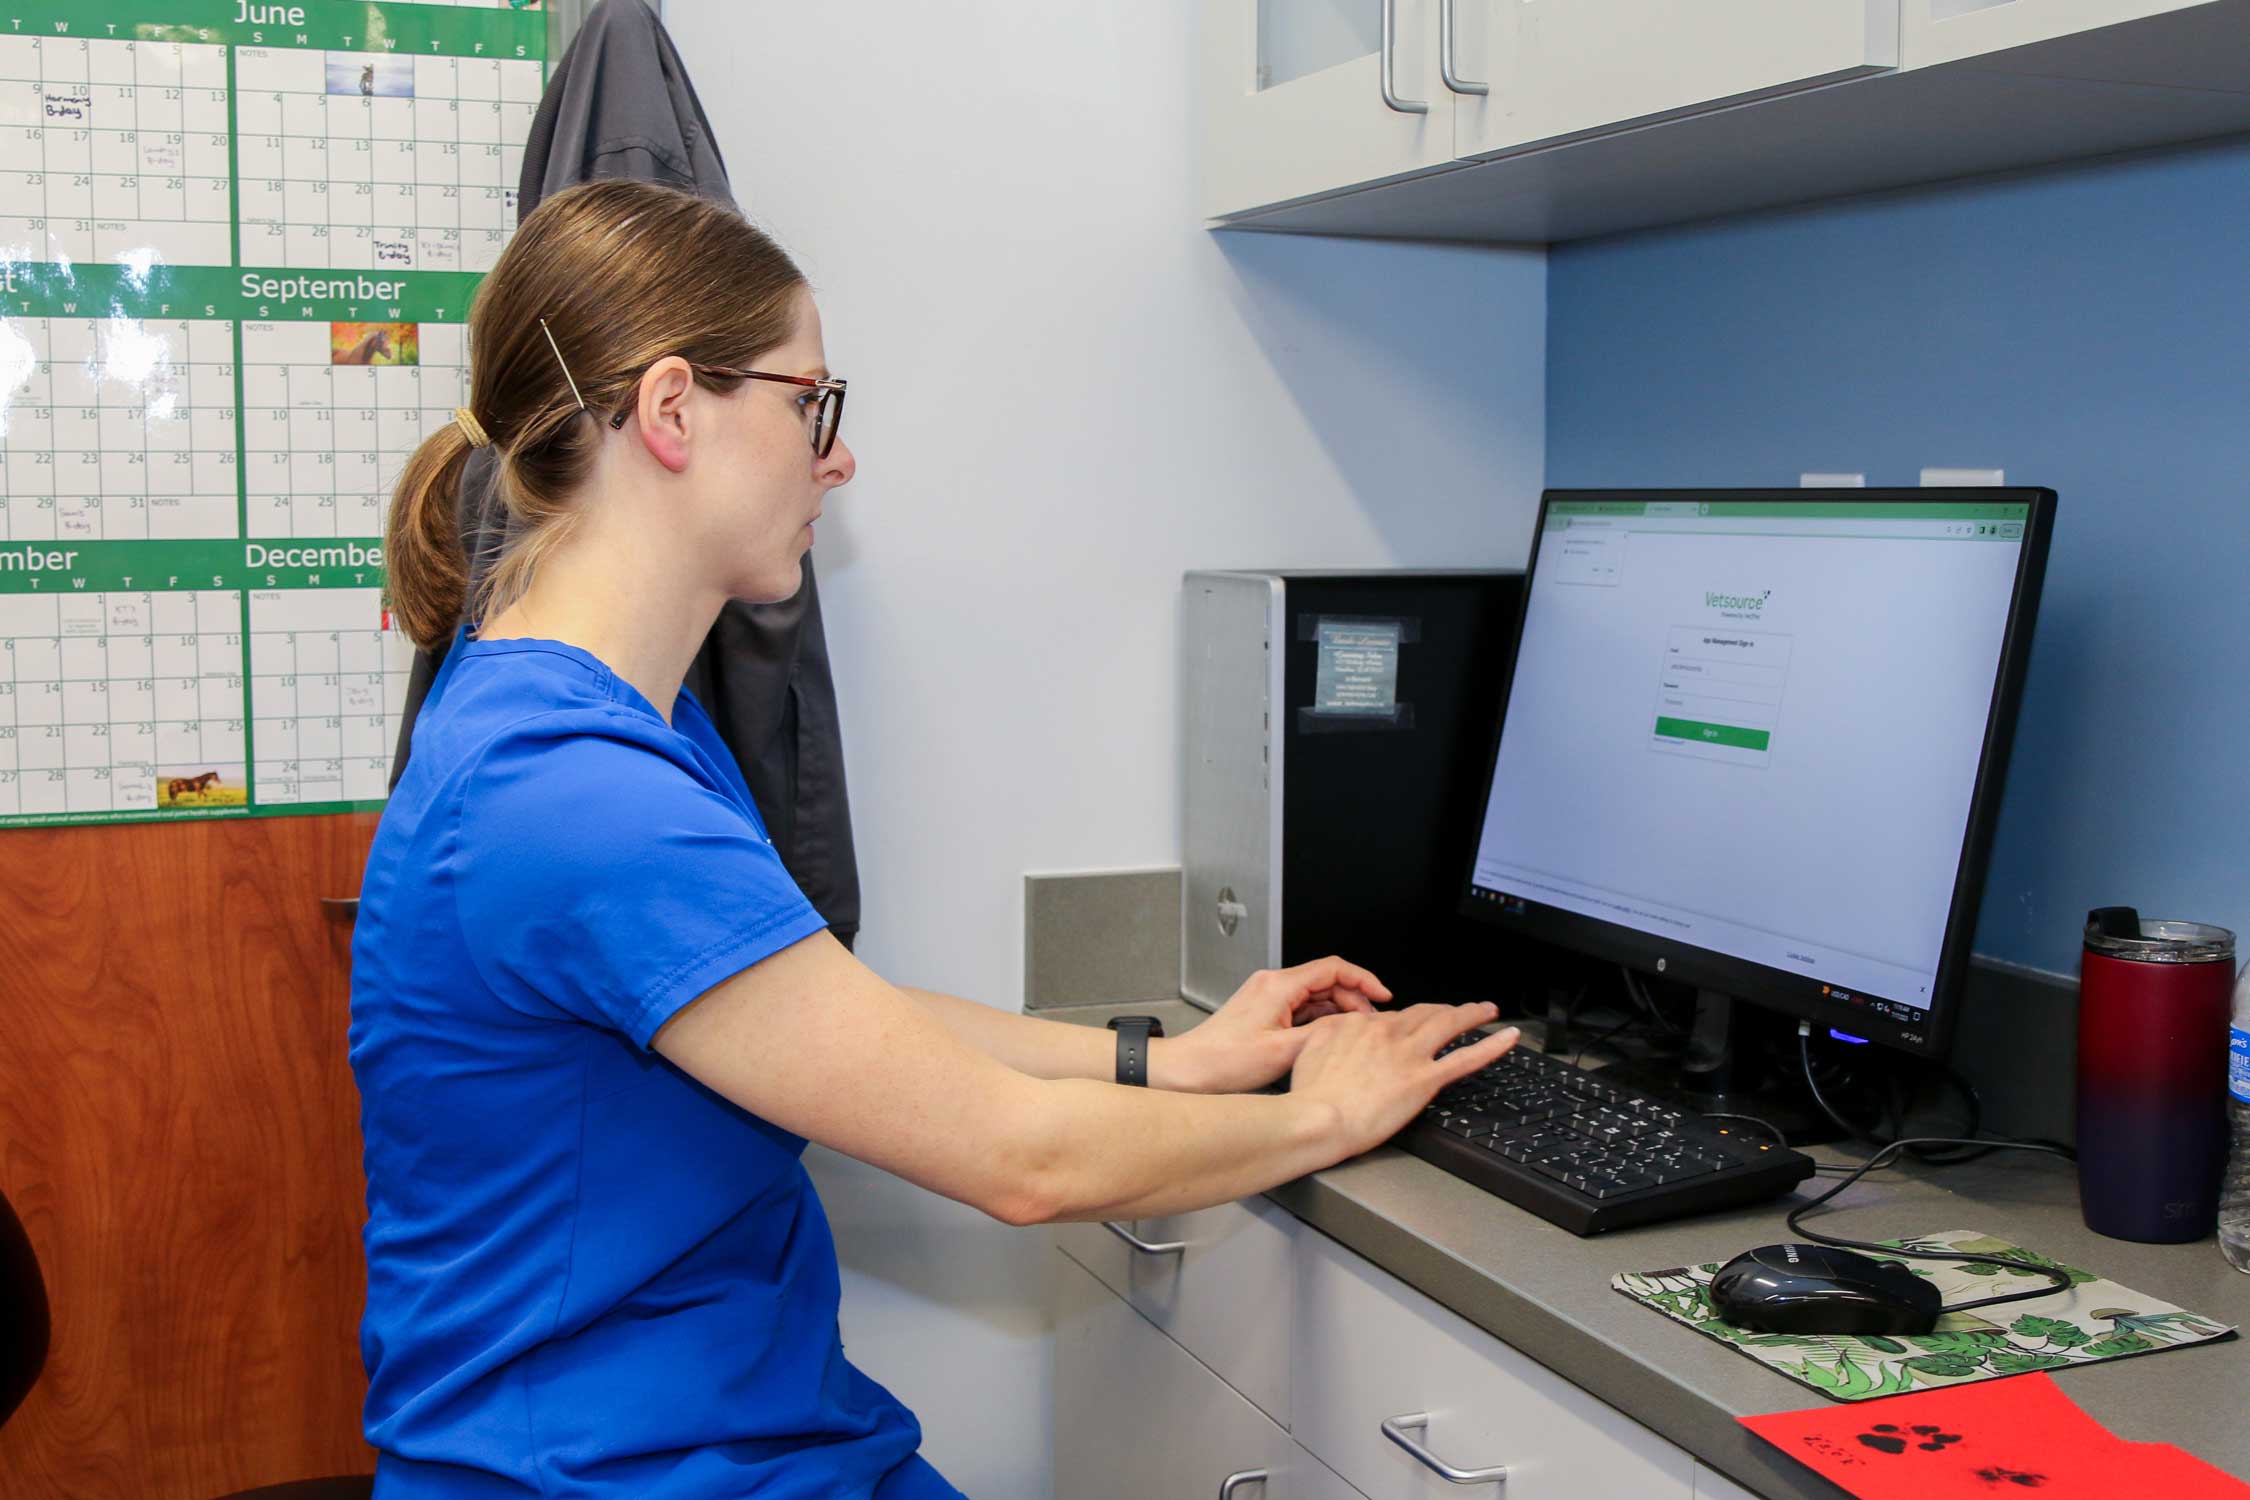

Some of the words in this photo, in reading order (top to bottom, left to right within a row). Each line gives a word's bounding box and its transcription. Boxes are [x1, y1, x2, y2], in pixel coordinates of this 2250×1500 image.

[235, 0, 304, 25] June
[12, 20, 21, 29] T
[56, 22, 68, 32] W
[107, 25, 116, 34] T
[154, 28, 161, 36] F
[200, 29, 208, 39] S
[254, 32, 262, 42] S
[297, 35, 307, 44] M
[344, 37, 351, 47] T
[384, 39, 395, 48] W
[432, 41, 439, 52] T
[475, 44, 482, 53] F
[516, 46, 525, 56] S
[218, 47, 226, 57] 6
[240, 50, 268, 58] NOTES
[33, 84, 41, 94] 9
[72, 86, 87, 96] 10
[120, 88, 133, 97] 11
[165, 90, 180, 100] 12
[211, 92, 225, 102] 13
[274, 94, 281, 103] 4
[319, 96, 326, 105] 5
[363, 97, 370, 107] 6
[450, 101, 457, 111] 8
[493, 103, 499, 113] 9
[26, 130, 41, 139] 16
[74, 131, 88, 141] 17
[120, 133, 135, 143] 18
[166, 135, 181, 145] 19
[212, 136, 226, 146] 20
[266, 138, 280, 147] 11
[311, 140, 326, 149] 12
[356, 141, 370, 151] 13
[400, 143, 413, 152] 14
[443, 144, 456, 154] 15
[486, 146, 499, 156] 16
[27, 175, 42, 185] 23
[74, 176, 89, 186] 24
[120, 178, 136, 188] 25
[166, 179, 182, 189] 26
[212, 181, 227, 190] 27
[268, 182, 281, 191] 18
[312, 184, 326, 193] 19
[355, 185, 371, 194] 20
[400, 186, 414, 195] 21
[443, 188, 457, 197] 22
[486, 189, 499, 198] 23
[28, 220, 44, 230] 30
[75, 221, 90, 231] 31
[268, 226, 282, 236] 25
[312, 227, 327, 237] 26
[356, 228, 371, 237] 27
[401, 229, 415, 239] 28
[443, 230, 457, 240] 29
[486, 231, 500, 241] 30
[242, 274, 406, 303] September
[22, 302, 29, 312] T
[64, 303, 77, 312] W
[162, 305, 169, 314] F
[206, 306, 214, 315] S
[260, 307, 268, 317] S
[303, 308, 312, 317] M
[349, 308, 357, 317] T
[389, 309, 400, 318] W
[436, 309, 444, 319] T
[88, 320, 95, 329] 2
[179, 322, 187, 331] 4
[225, 322, 232, 332] 5
[246, 324, 273, 332] NOTES
[41, 364, 49, 374] 8
[218, 366, 232, 376] 12
[35, 409, 49, 419] 15
[81, 410, 96, 419] 16
[128, 410, 142, 419] 17
[174, 410, 188, 420] 18
[219, 411, 233, 420] 19
[272, 411, 287, 420] 10
[317, 411, 330, 420] 11
[361, 411, 375, 420] 12
[405, 411, 418, 421] 13
[36, 454, 51, 463] 22
[82, 454, 97, 463] 23
[128, 454, 143, 463] 24
[174, 454, 189, 463] 25
[220, 454, 234, 463] 26
[272, 454, 287, 463] 17
[318, 455, 332, 463] 18
[362, 455, 376, 463] 19
[37, 498, 52, 508] 29
[84, 498, 100, 508] 30
[130, 498, 144, 508] 31
[152, 499, 179, 507] NOTES
[274, 497, 289, 507] 24
[318, 497, 333, 507] 25
[362, 497, 377, 506] 26
[246, 543, 385, 568] Decembe
[31, 579, 39, 589] T
[73, 578, 86, 588] W
[124, 577, 132, 587] T
[170, 577, 178, 586] F
[214, 576, 222, 586] S
[267, 575, 275, 585] S
[309, 575, 319, 584] M
[356, 574, 363, 584] T
[1706, 592, 1764, 610] Vetsource
[181, 637, 195, 646] 10
[226, 636, 239, 645] 11
[46, 683, 59, 692] 14
[92, 683, 106, 692] 15
[137, 681, 151, 691] 16
[182, 680, 196, 689] 17
[227, 679, 241, 688] 18
[281, 677, 296, 687] 10
[324, 676, 337, 685] 11
[368, 675, 382, 685] 12
[0, 728, 15, 738] 20
[46, 727, 60, 736] 21
[93, 726, 107, 736] 22
[138, 725, 153, 734] 23
[184, 723, 198, 732] 24
[228, 722, 242, 731] 25
[282, 720, 296, 730] 17
[326, 719, 340, 728] 18
[369, 718, 383, 727] 19
[282, 762, 297, 772] 24
[326, 761, 341, 771] 25
[369, 759, 384, 769] 26
[1, 772, 16, 782] 27
[48, 771, 63, 780] 28
[94, 770, 109, 779] 29
[140, 768, 155, 777] 30
[283, 784, 296, 794] 31
